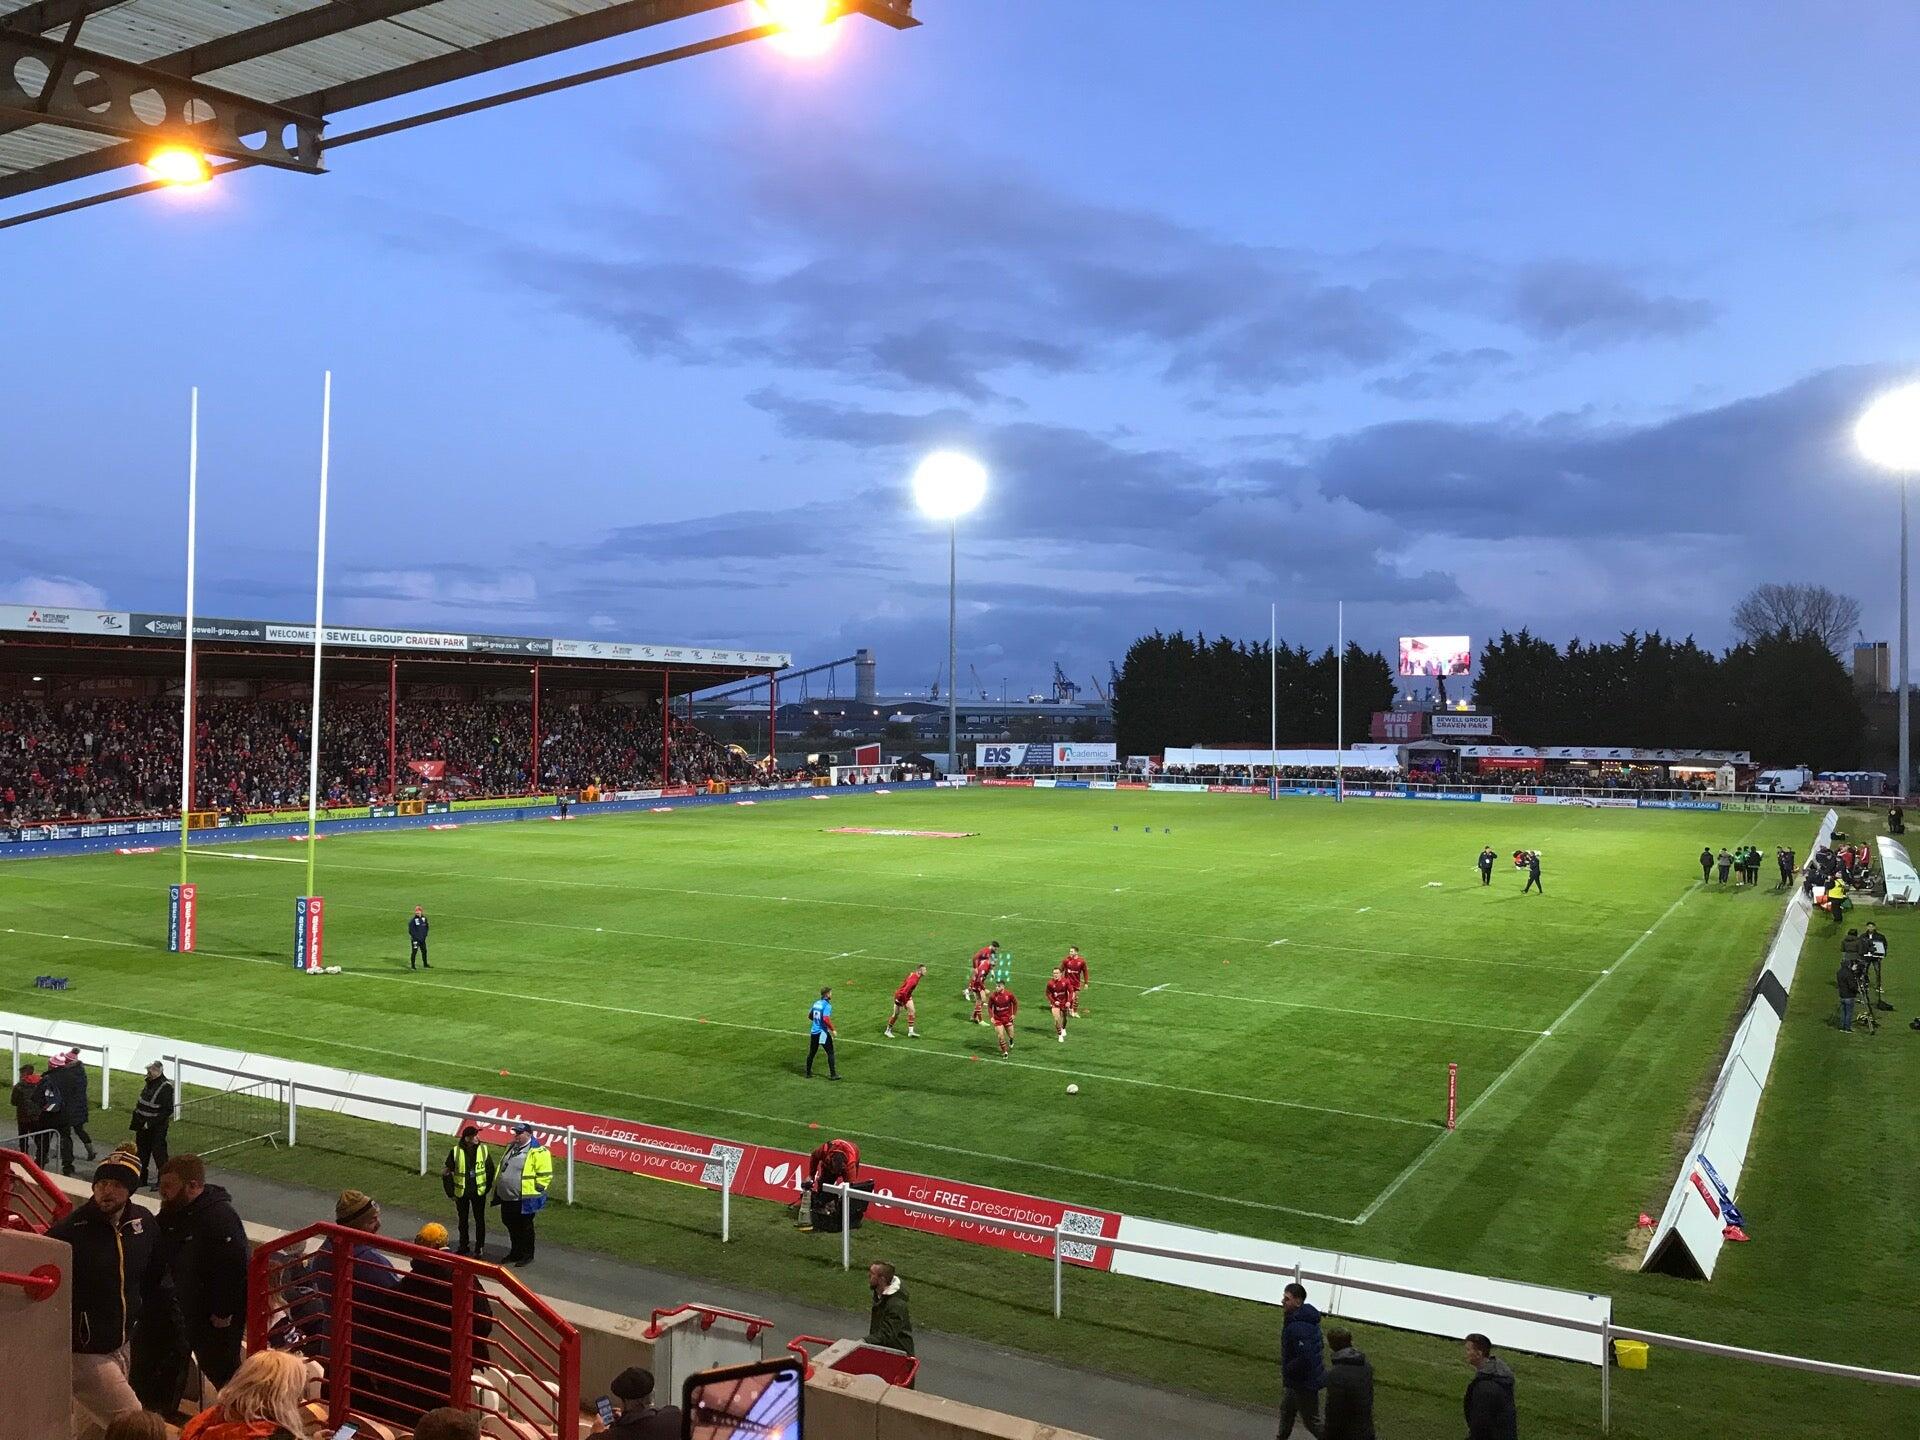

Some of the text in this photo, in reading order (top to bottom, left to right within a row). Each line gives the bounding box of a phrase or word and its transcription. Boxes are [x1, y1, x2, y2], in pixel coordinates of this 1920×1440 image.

[155, 620, 182, 630] Sewell
[192, 626, 260, 636] sewell-group.co.uk
[269, 629, 310, 639] WELCOME
[326, 632, 367, 643] SEWELL
[369, 634, 403, 644] GROUP
[405, 636, 441, 646] CRAVEN
[443, 637, 465, 647] PARK
[531, 641, 549, 650] Sewell
[983, 747, 1012, 764] EYS
[1374, 790, 1407, 798] BETFRED
[1500, 795, 1512, 804] sky
[184, 901, 192, 950] BETFRED
[311, 915, 319, 967] BETFRED
[611, 1129, 639, 1142] FREE
[585, 1142, 698, 1174] delivery to your door
[475, 1160, 485, 1170] 22
[908, 1185, 931, 1200] For
[933, 1189, 969, 1208] FREE
[969, 1199, 1052, 1226] prescription
